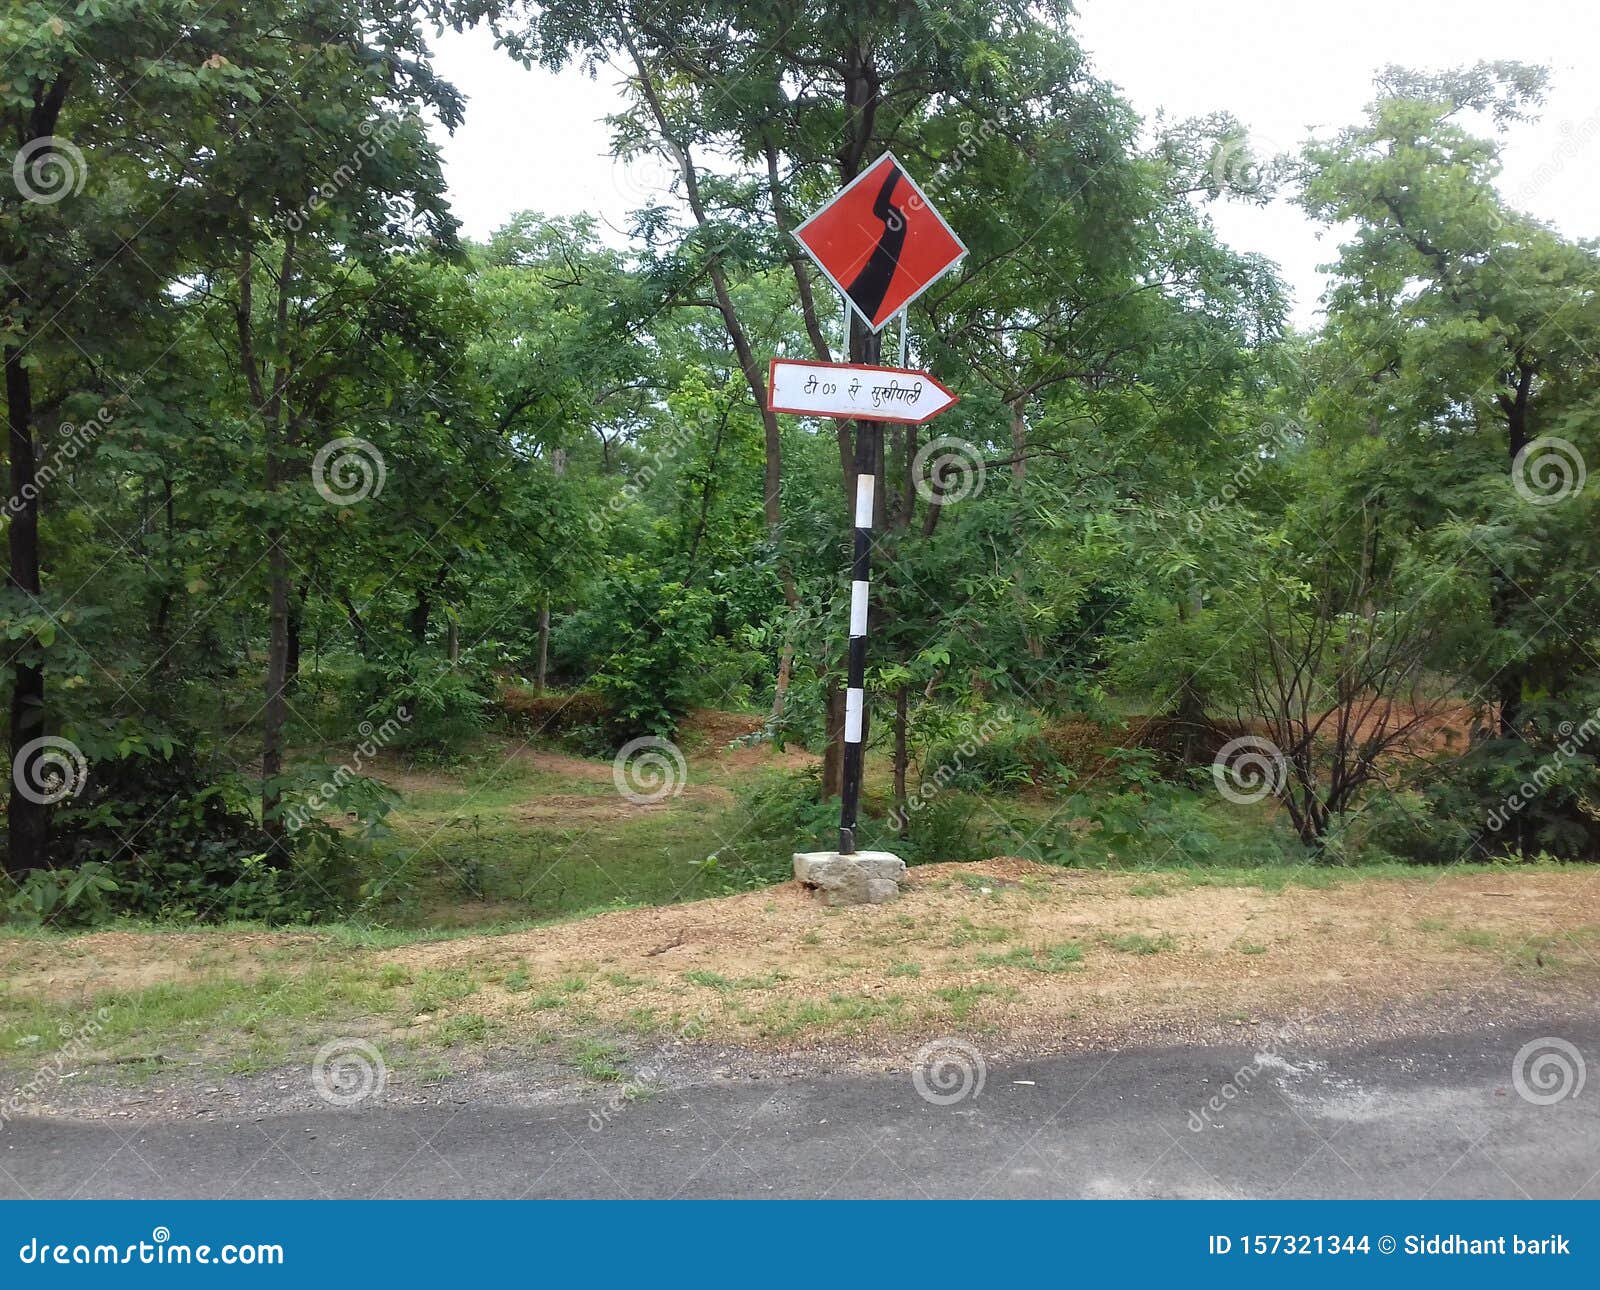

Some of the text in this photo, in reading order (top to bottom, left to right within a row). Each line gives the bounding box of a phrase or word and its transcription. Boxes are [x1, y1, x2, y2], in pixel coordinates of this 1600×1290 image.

[803, 374, 819, 395] टी
[848, 377, 862, 401] से
[871, 379, 922, 408] सुखीपाली
